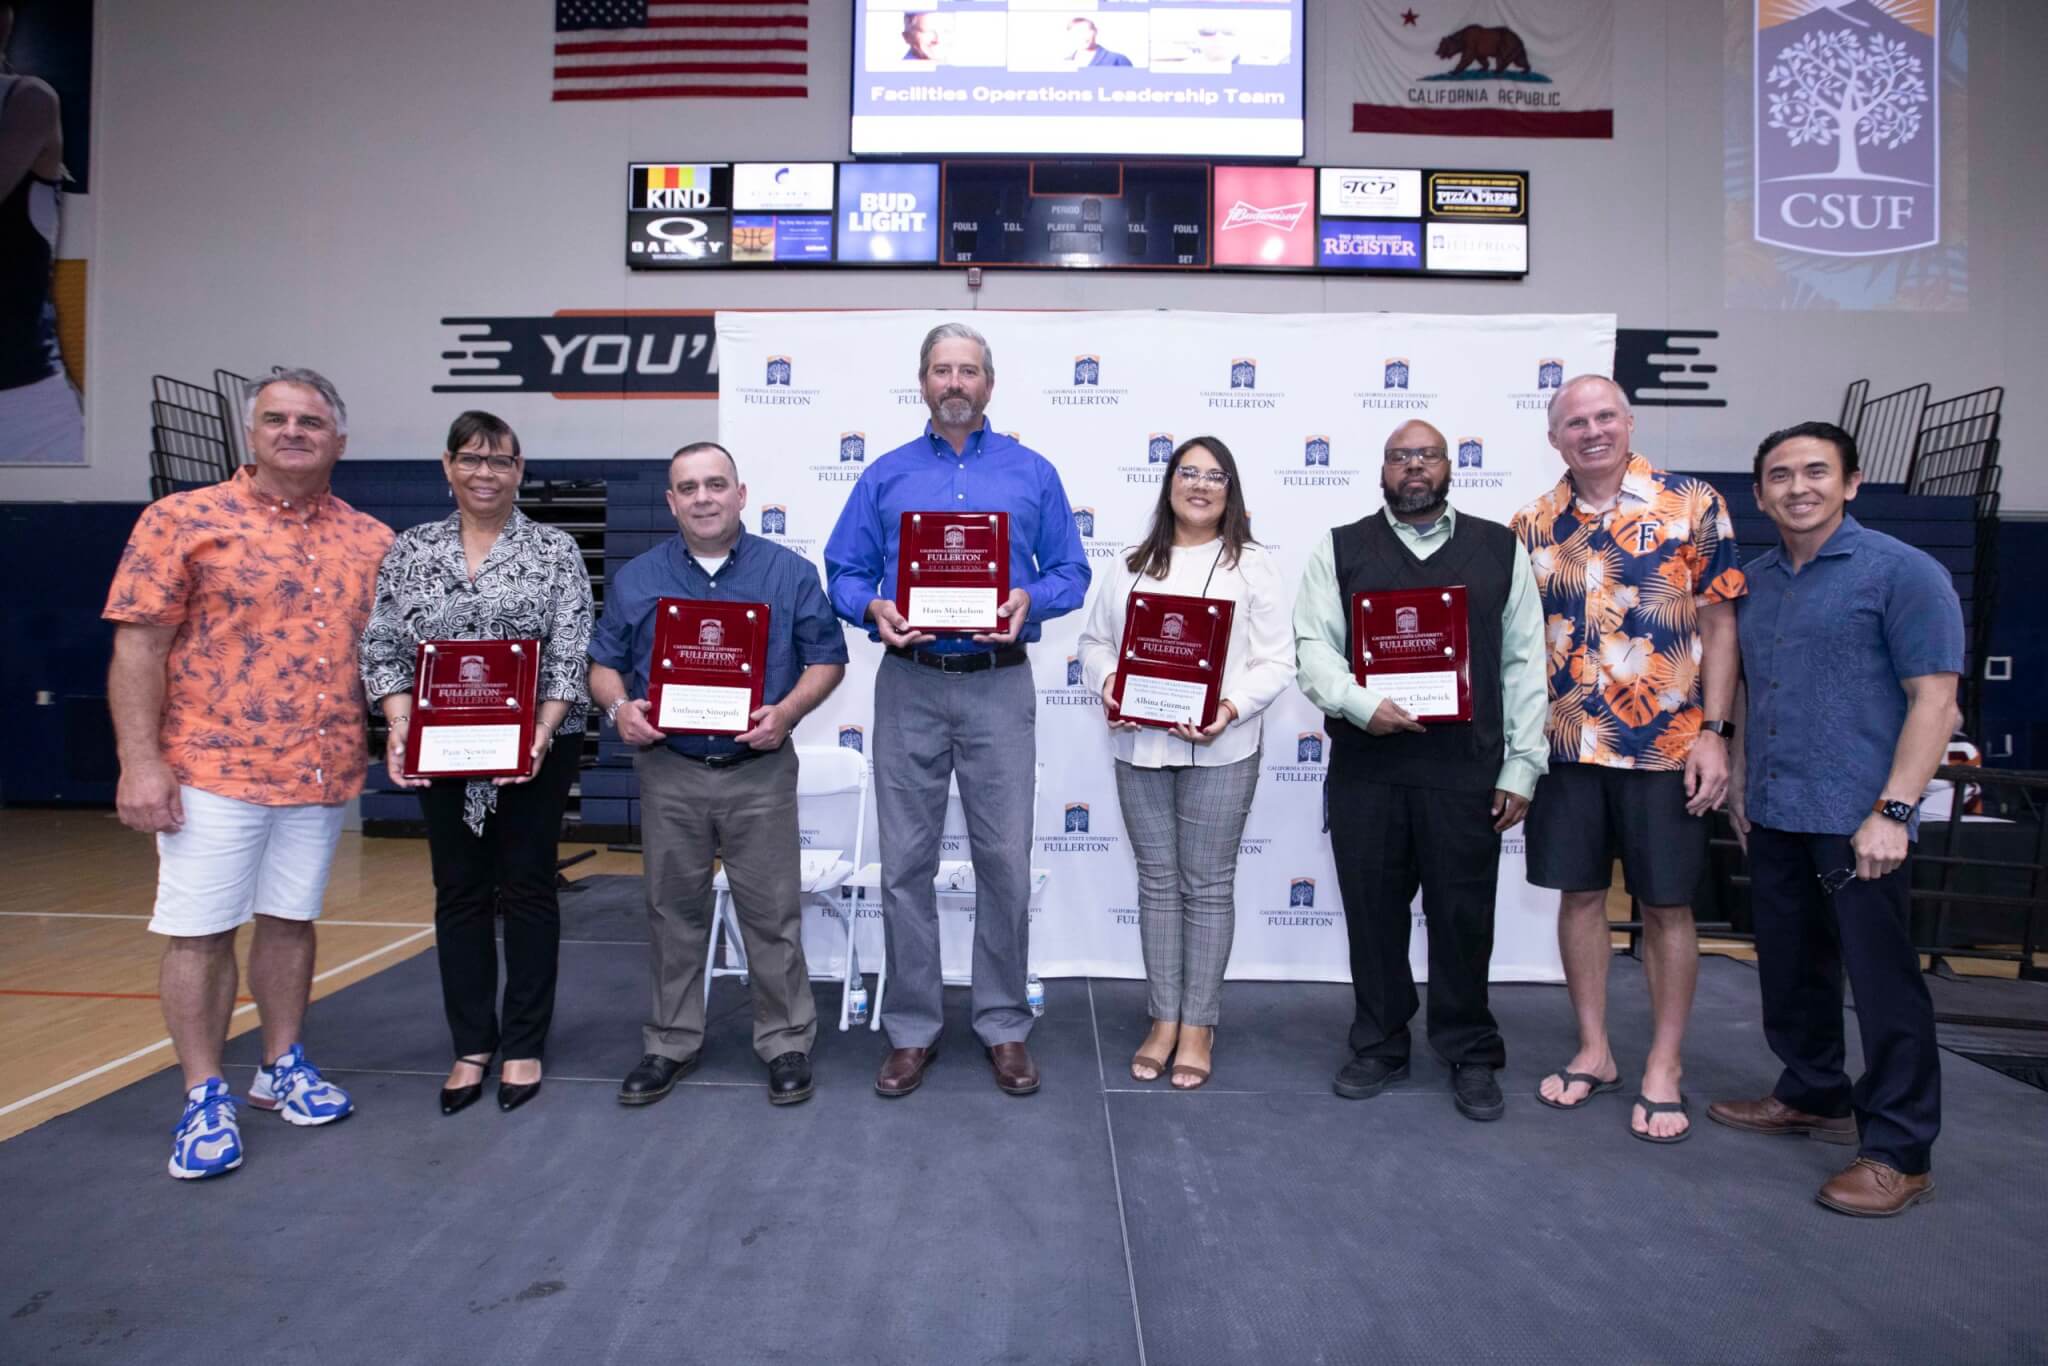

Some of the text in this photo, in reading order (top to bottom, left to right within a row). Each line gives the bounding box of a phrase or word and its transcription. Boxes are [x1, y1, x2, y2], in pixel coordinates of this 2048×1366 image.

[871, 86, 1285, 106] Facilities Operations Leadership Team
[1408, 88, 1561, 106] CALIFORNIA REPUBLIC
[1343, 181, 1396, 194] TCP
[647, 190, 711, 208] KIND
[859, 192, 917, 211] BUD
[1437, 190, 1477, 205] PIZZA
[1051, 206, 1080, 215] PERIOD
[1780, 192, 1915, 230] CSUF
[849, 212, 926, 232] LIGHT
[953, 223, 978, 232] FOULS
[1047, 223, 1104, 232] PLAYER FOUL
[1173, 225, 1198, 234] FOULS
[1323, 238, 1417, 256] REGISTER
[957, 253, 972, 262] SET
[1178, 255, 1193, 264] SET
[744, 394, 811, 406] FULLERTON
[1052, 396, 1119, 405] FULLERTON
[1208, 398, 1276, 408] FULLERTON
[1362, 399, 1429, 409] FULLERTON
[1283, 476, 1350, 486] FULLERTON
[1636, 521, 1661, 554] F
[1379, 638, 1436, 649] FULLERTON
[1143, 642, 1194, 656] FULLERTON
[680, 650, 736, 660] FULLERTON
[438, 688, 500, 697] FULLERTON
[1043, 842, 1109, 852] FULLERTON
[1267, 916, 1334, 926] FULLERTON
